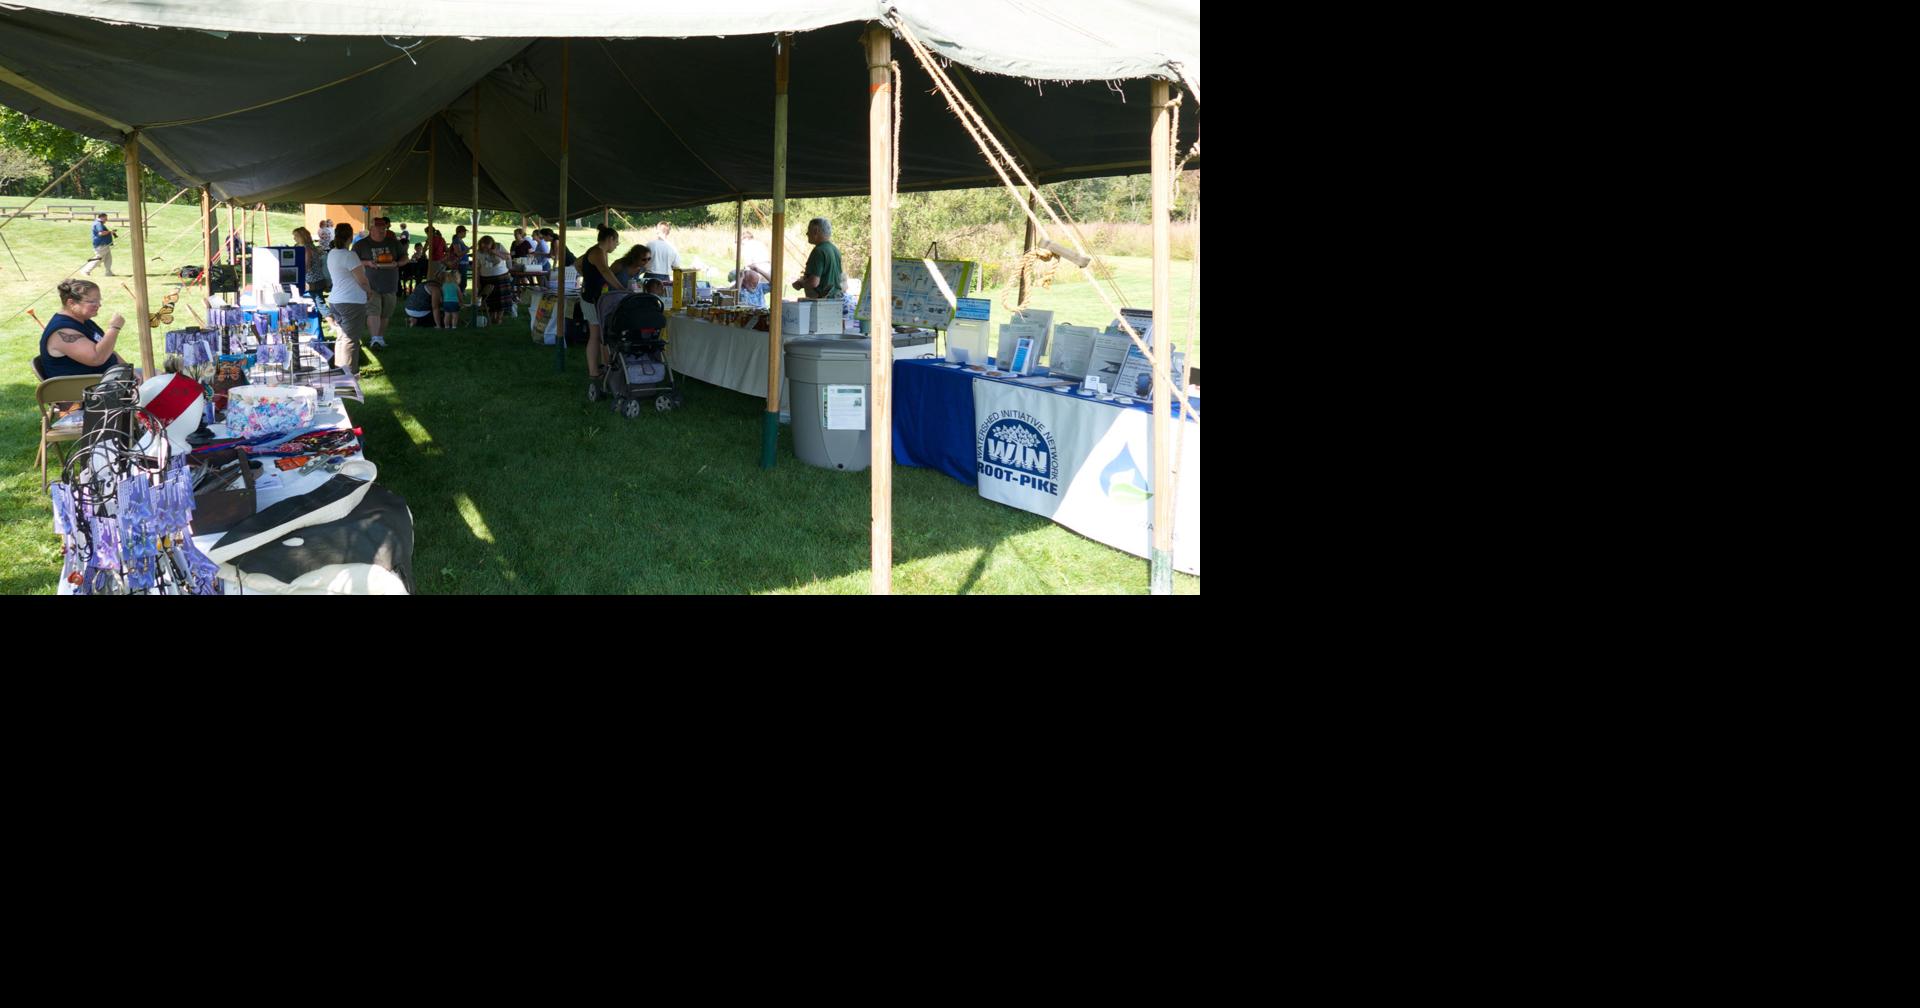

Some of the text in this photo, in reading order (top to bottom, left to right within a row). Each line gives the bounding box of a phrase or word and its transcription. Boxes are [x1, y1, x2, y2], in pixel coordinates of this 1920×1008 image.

[977, 410, 1058, 481] WATERSHED INITIATIVE NETWORK
[987, 437, 1048, 474] WIN
[977, 461, 1058, 496] ROOT-PIKE
